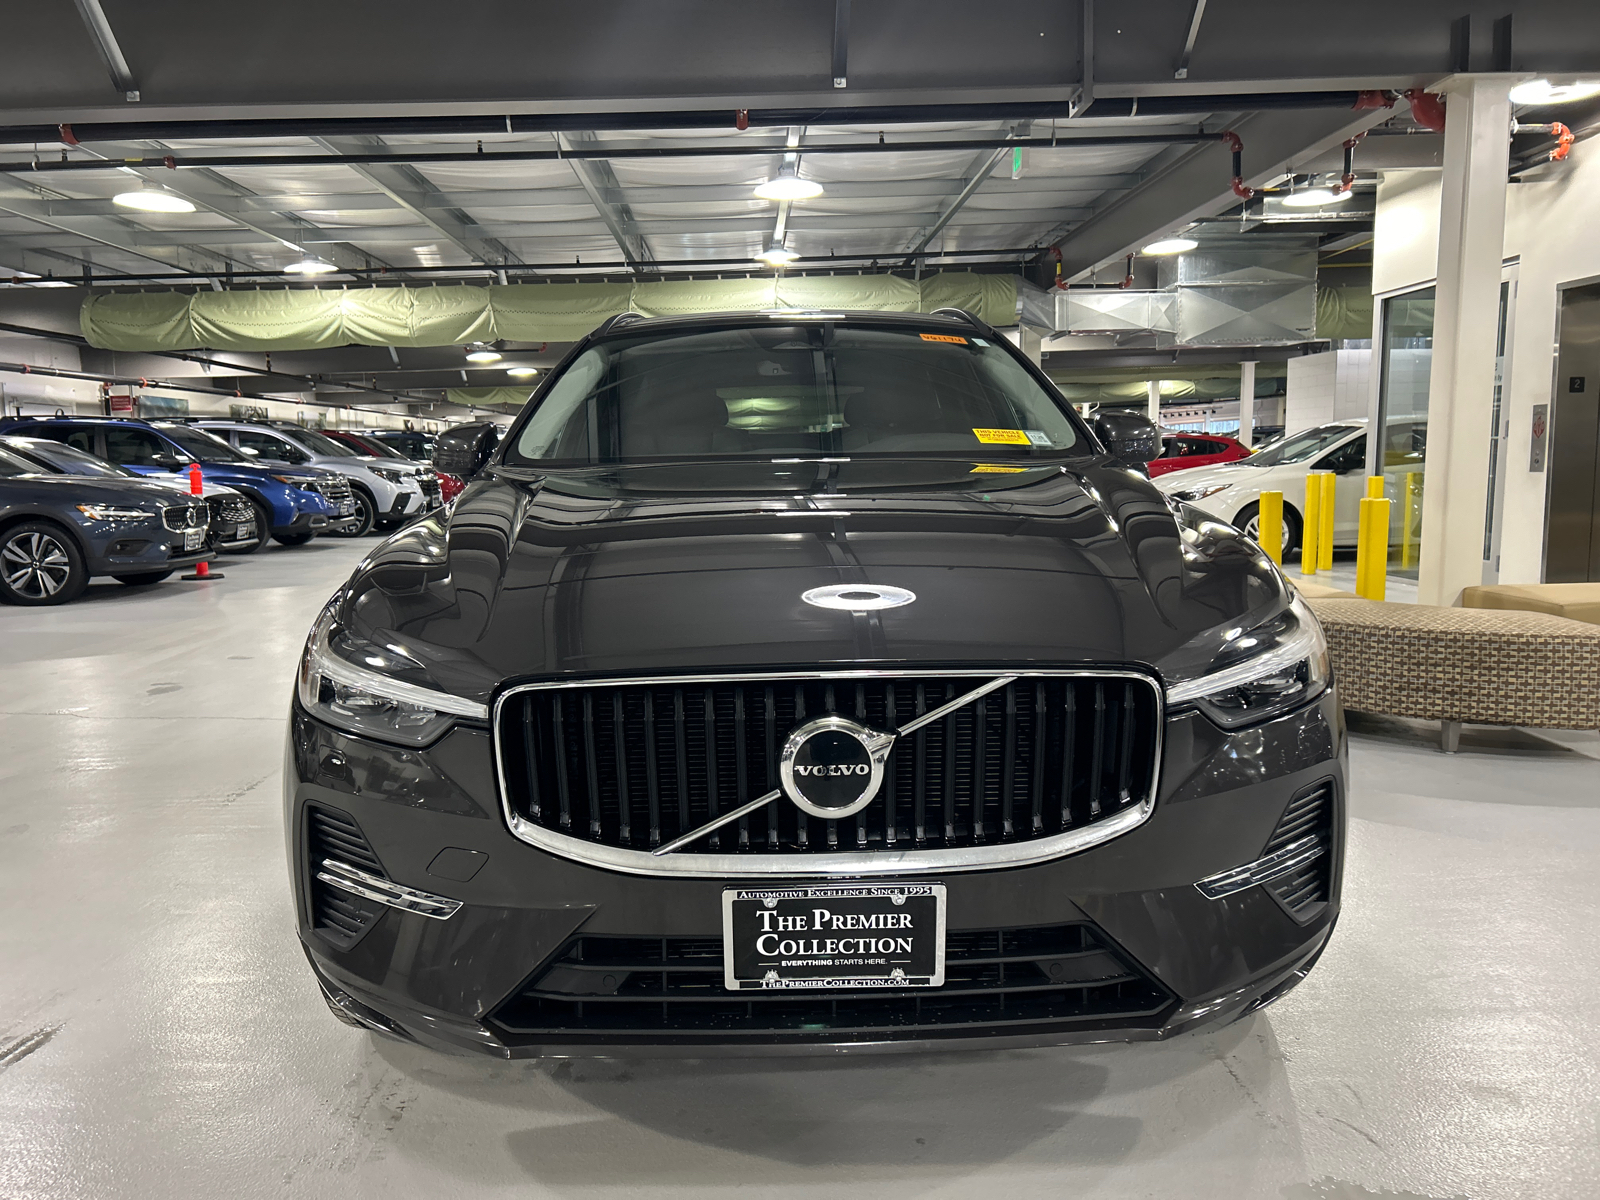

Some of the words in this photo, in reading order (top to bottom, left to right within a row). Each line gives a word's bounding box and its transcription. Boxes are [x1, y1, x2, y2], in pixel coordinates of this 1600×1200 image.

[1574, 378, 1581, 389] 2
[794, 764, 869, 776] VOLVO
[807, 888, 869, 897] EXCELLENCE
[870, 887, 901, 896] SINCE
[903, 886, 931, 895] 1995
[756, 909, 808, 932] THE
[812, 909, 914, 930] PREMIER
[756, 933, 914, 956] COLLECTION
[781, 959, 833, 967] EVERYTHING
[834, 958, 864, 966] STARTS
